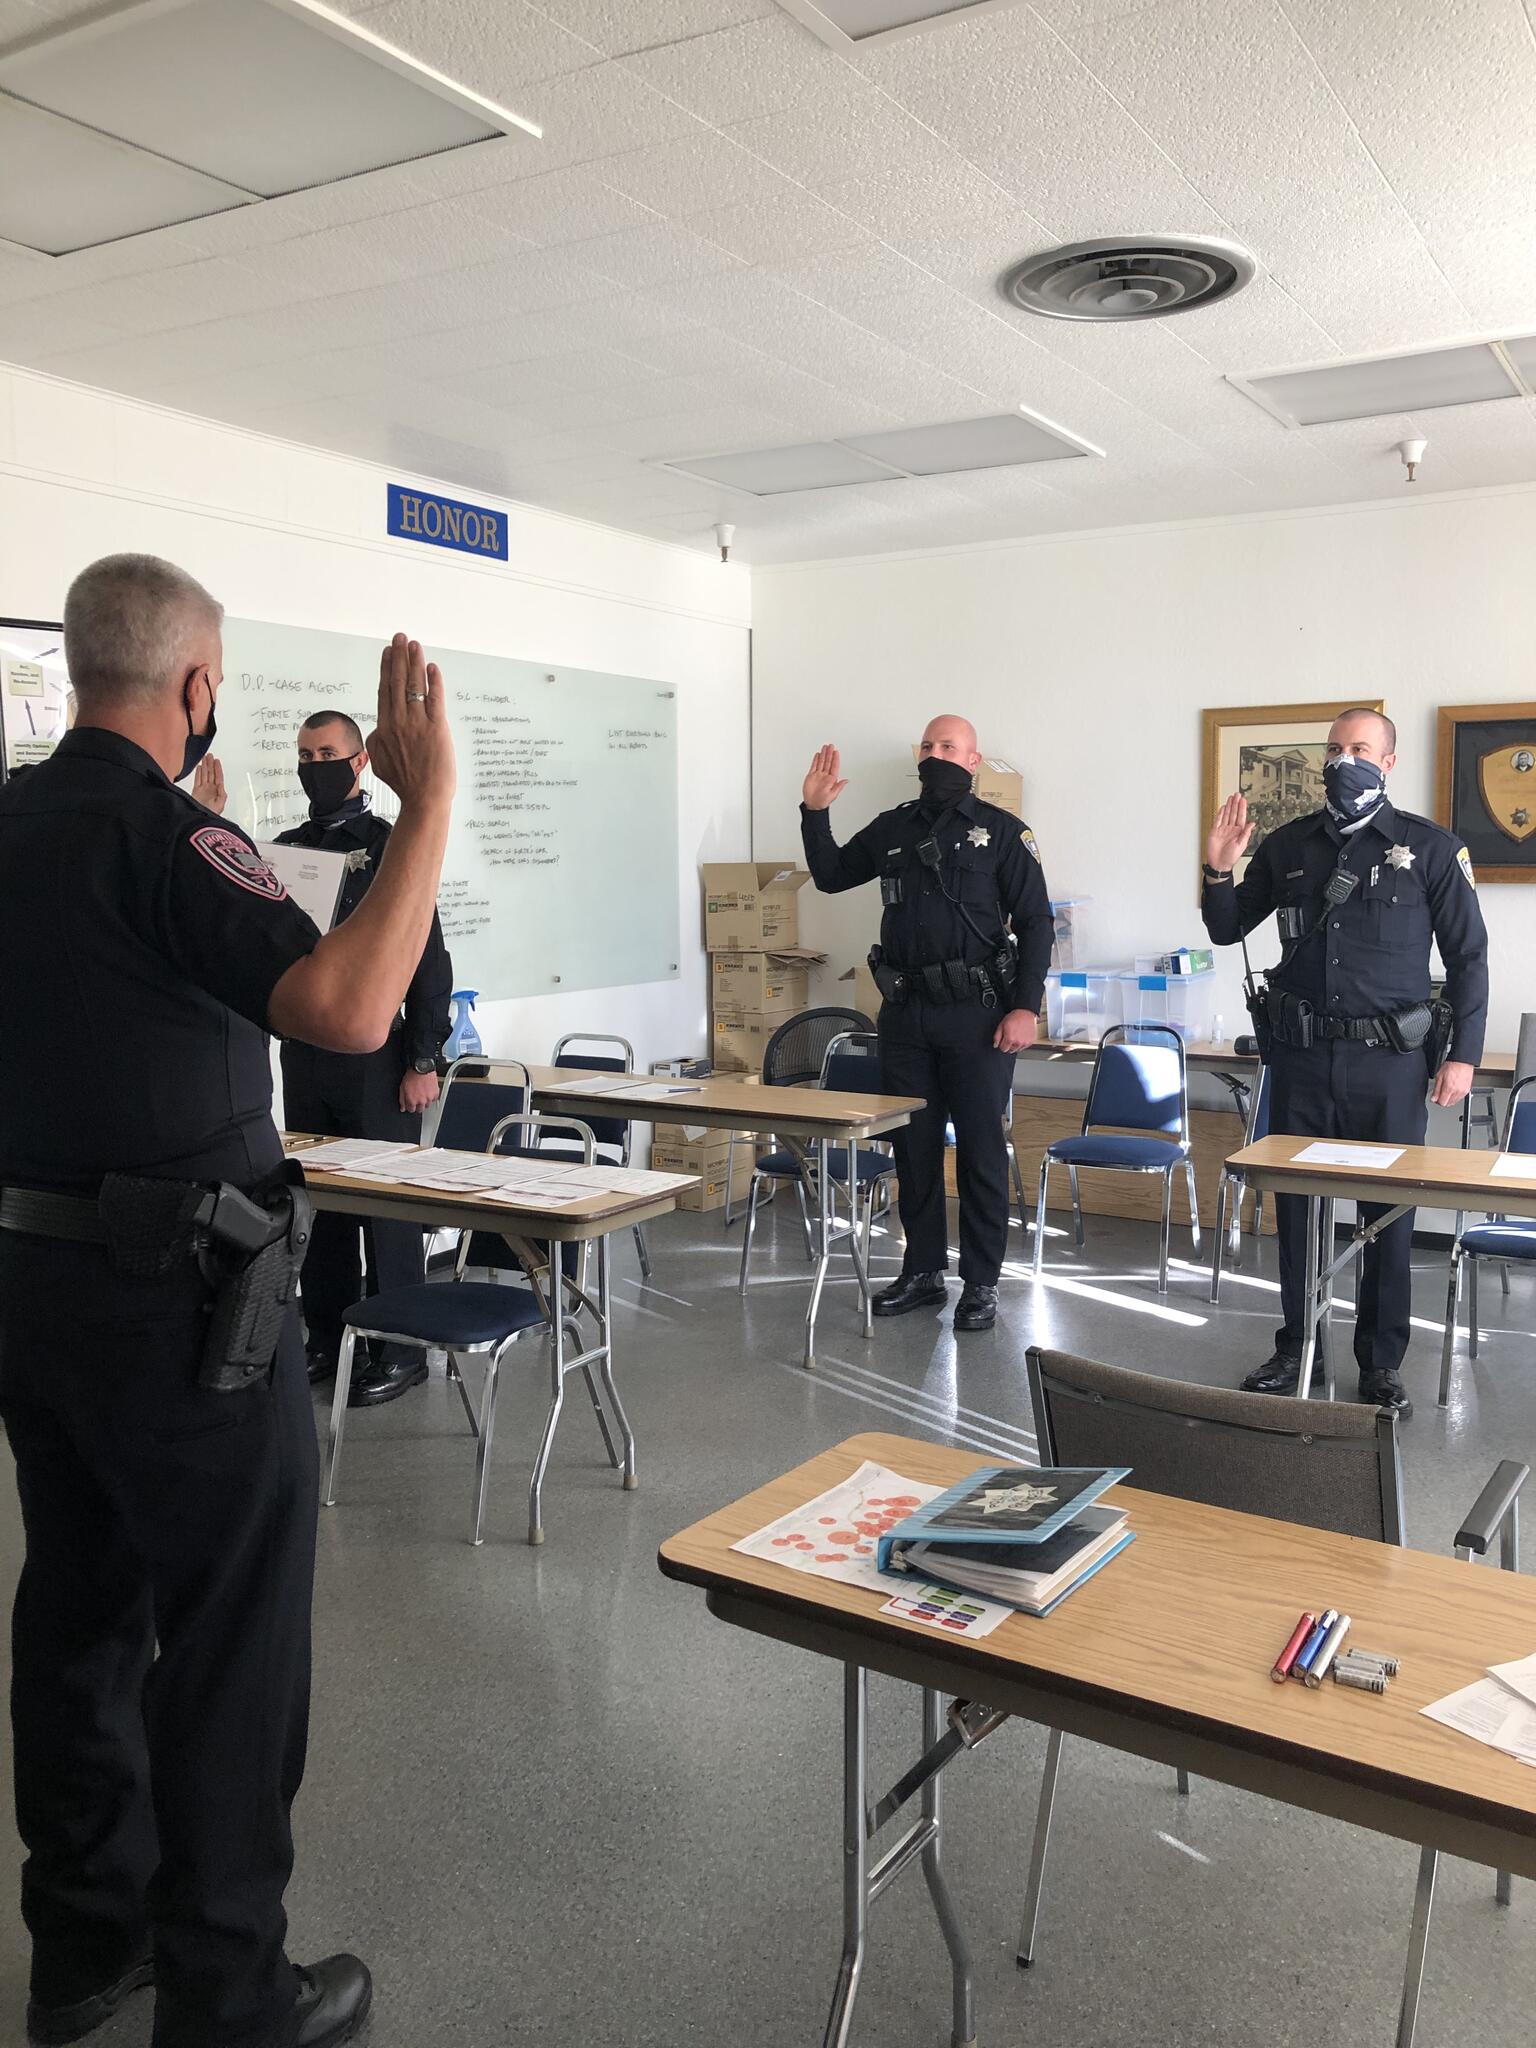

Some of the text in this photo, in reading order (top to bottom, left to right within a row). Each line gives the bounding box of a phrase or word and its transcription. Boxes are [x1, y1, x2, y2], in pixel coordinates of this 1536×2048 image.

[400, 494, 500, 552] HONOR
[260, 707, 291, 721] FORTE
[262, 767, 294, 777] SEARCH
[263, 790, 289, 801] FORTE
